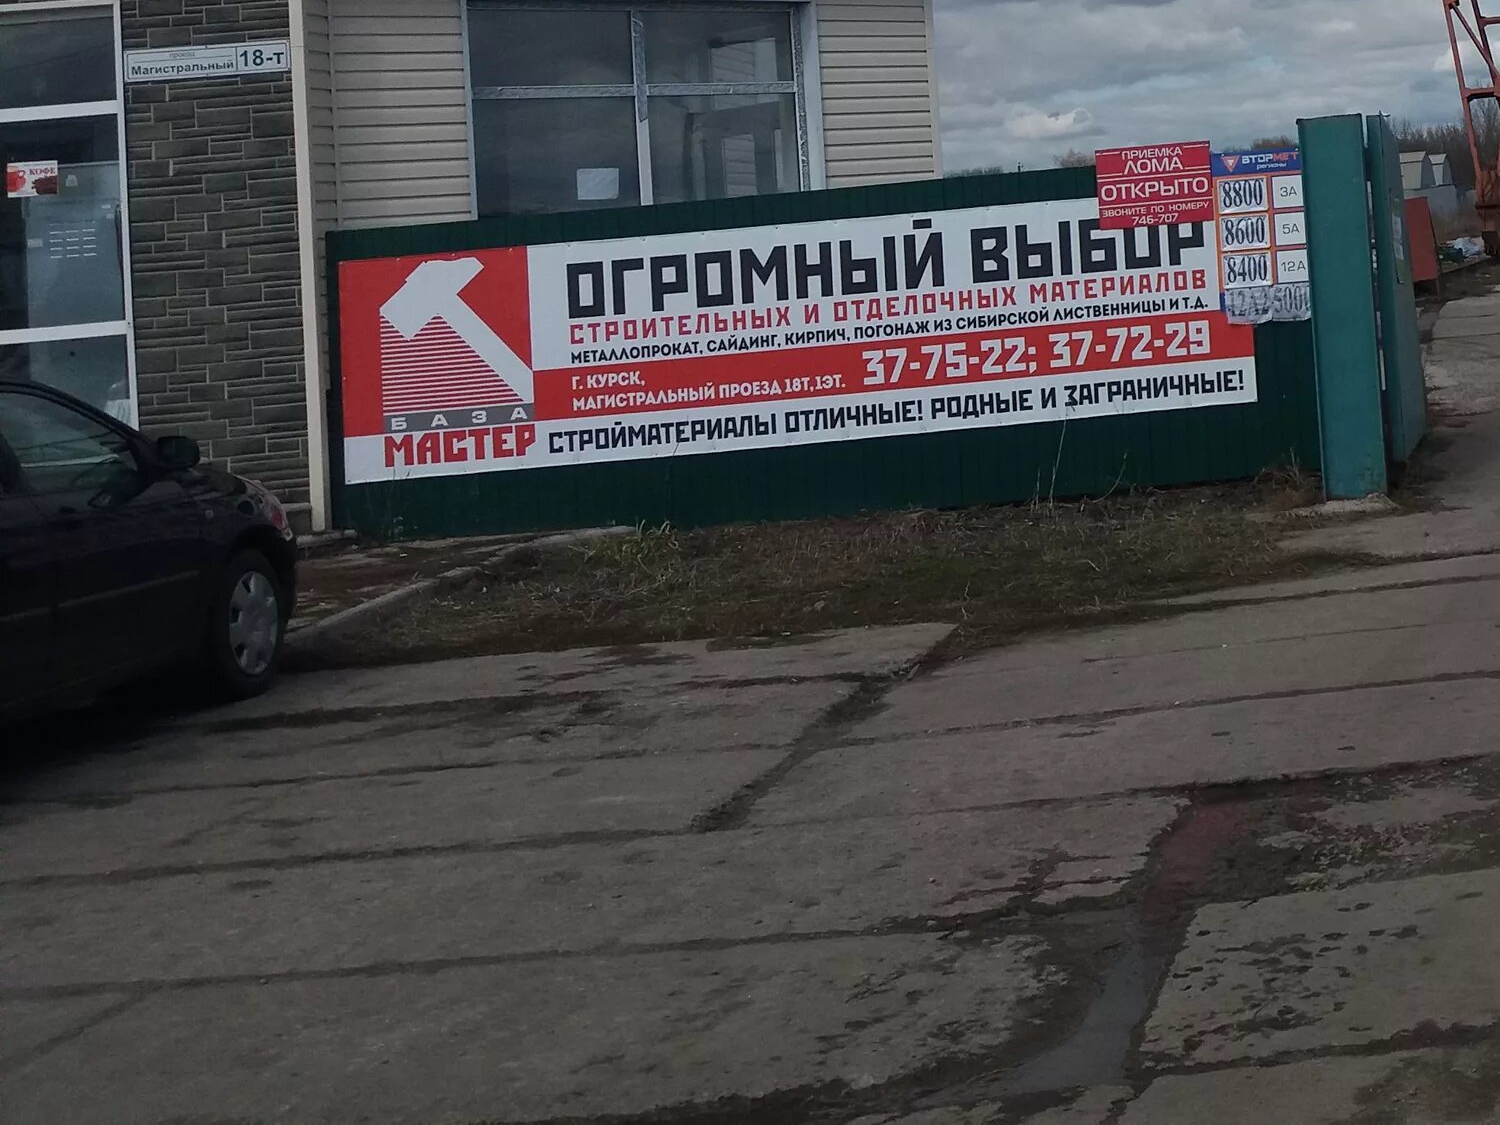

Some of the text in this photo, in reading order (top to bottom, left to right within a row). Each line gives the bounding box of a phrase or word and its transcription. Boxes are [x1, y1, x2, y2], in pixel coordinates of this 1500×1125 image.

[131, 60, 234, 75] Магистральный
[239, 49, 285, 67] 18-т
[1121, 146, 1183, 160] ПРИЕМКА
[1123, 156, 1184, 175] ЛОМА
[1241, 152, 1299, 164] ВТОРМЕТ
[29, 166, 56, 175] КОФЕ
[1256, 162, 1286, 170] регионы
[1101, 176, 1209, 202] ОТКРЫТО
[1222, 179, 1298, 208] 8800 3А
[1102, 201, 1210, 218] ЗВОНИТЕ ПО НОМЕРУ
[1132, 213, 1179, 226] 746-707
[1225, 217, 1300, 246] 8600 5А
[566, 218, 1205, 319] ОГРОМНЫЙ ВЫБОР
[1227, 255, 1267, 283] 8400
[570, 268, 1207, 345] СТРОИТЕЛЬНЫХ И ОТДЕЛОЧНЫХ МАТЕРИАЛОВ
[571, 295, 1209, 364] МЕТАЛЛОПРОКАТ, САЙДИНГ, КИРПИЧ, ПОГОНАЖ ИЗ СИБИРСКОЙ ЛИСТВЕННИЦЫ И Т.Д.
[862, 319, 1211, 386] 37-75-22; 37-72-29
[571, 370, 646, 390] Г. КУРСК,
[572, 382, 716, 411] МАГИСТРАЛЬНЫЙ
[719, 378, 782, 399] ПРОЕЗД
[391, 407, 528, 431] БАЗА
[548, 369, 1245, 454] СТРОЙМАТЕРИАЛЫ ОТЛИЧНЫЕ! РОДНЫЕ И ЗАГРАНИЧНЫЕ!
[384, 424, 536, 468] МАСТЕР
